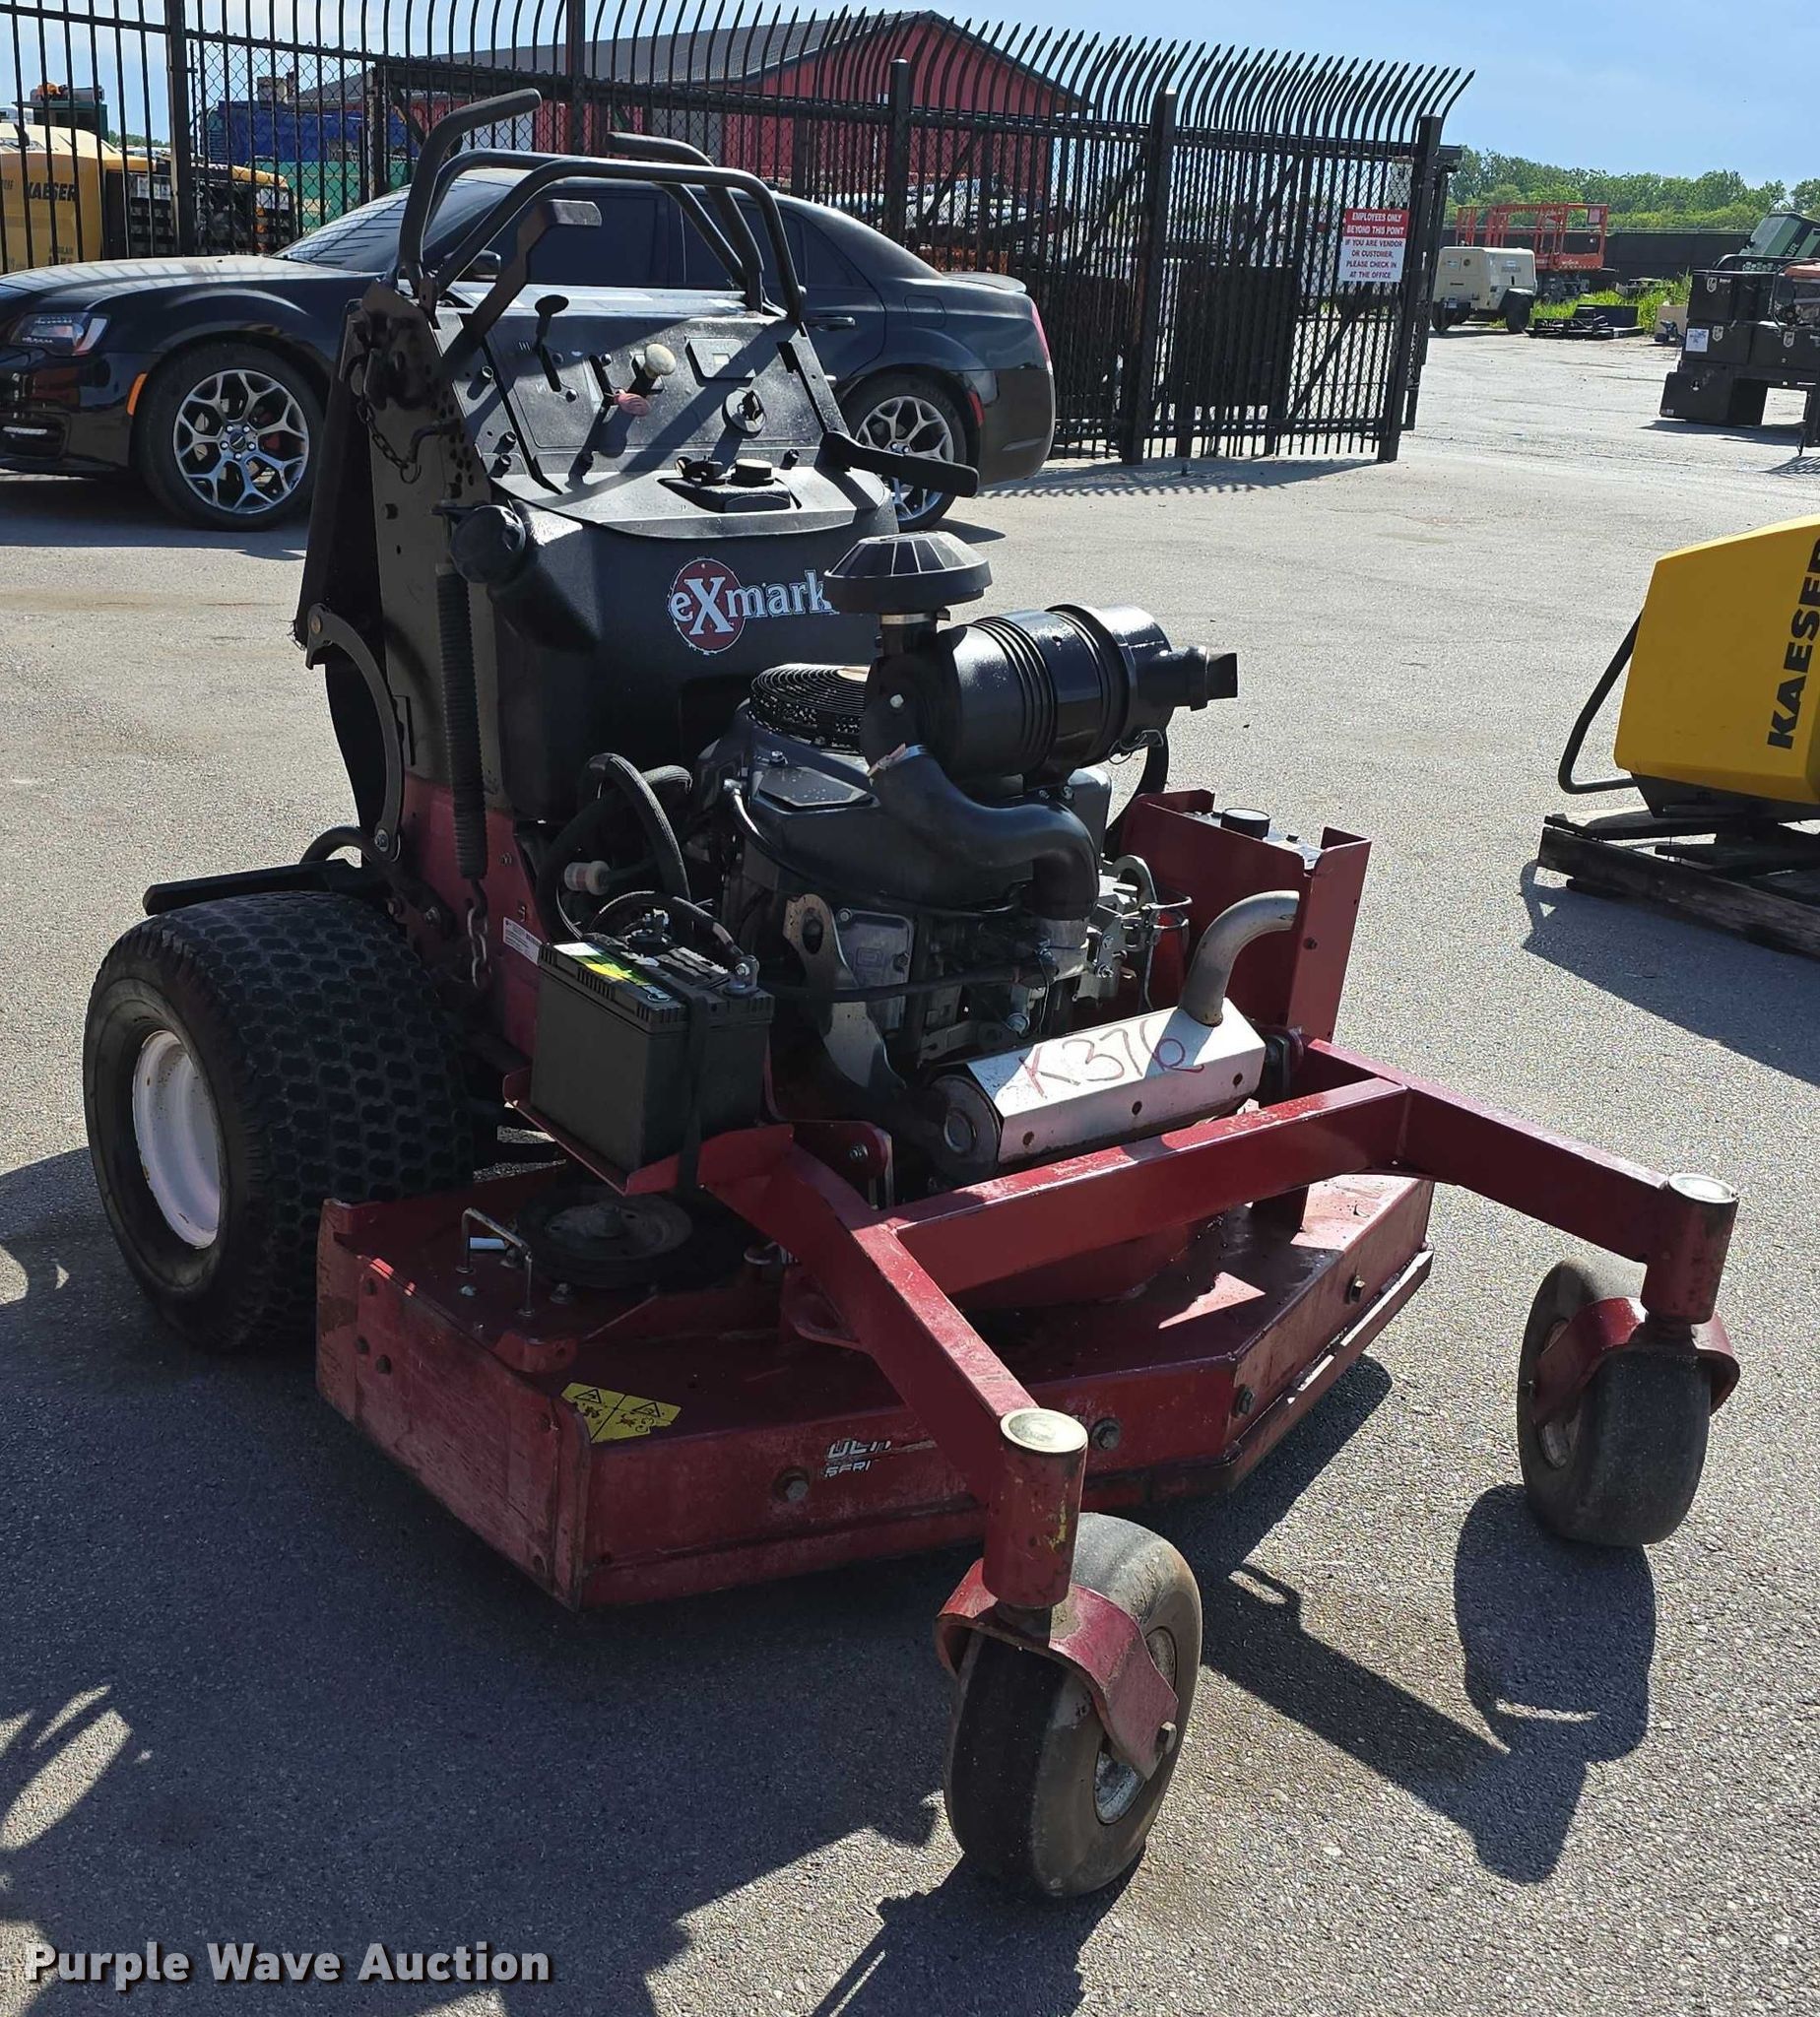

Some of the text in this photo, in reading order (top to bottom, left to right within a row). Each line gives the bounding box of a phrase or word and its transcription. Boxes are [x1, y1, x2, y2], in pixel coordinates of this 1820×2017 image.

[1351, 212, 1402, 223] EMPLOYEES ONLY
[1346, 225, 1404, 235] BEYOND THIS POINT
